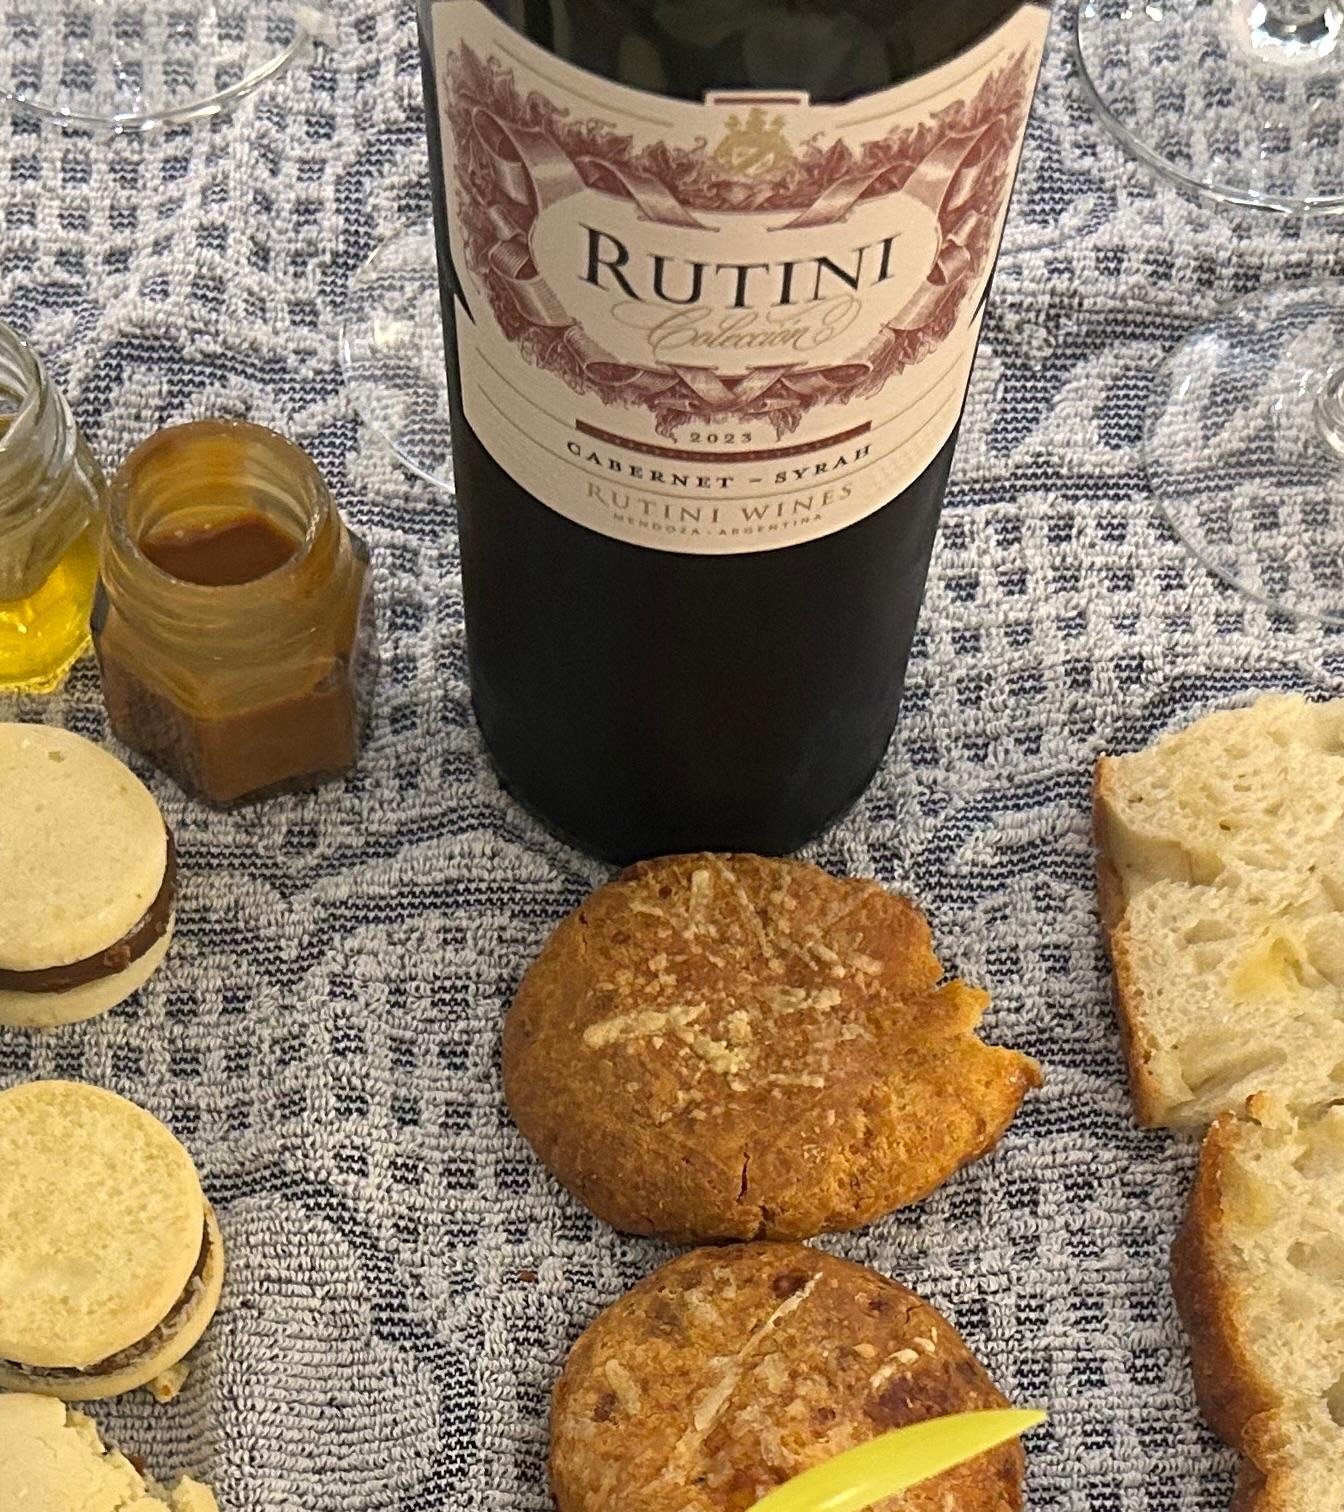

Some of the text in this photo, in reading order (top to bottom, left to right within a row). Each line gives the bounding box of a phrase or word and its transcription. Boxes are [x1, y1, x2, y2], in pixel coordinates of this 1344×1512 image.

[577, 221, 902, 309] RUTINI
[689, 431, 754, 445] 2023
[566, 441, 735, 489] CABERNET
[774, 443, 874, 485] SYRAH
[586, 481, 854, 525] RUTINI WINES
[613, 512, 823, 536] MENDOZA ARGENTINA
